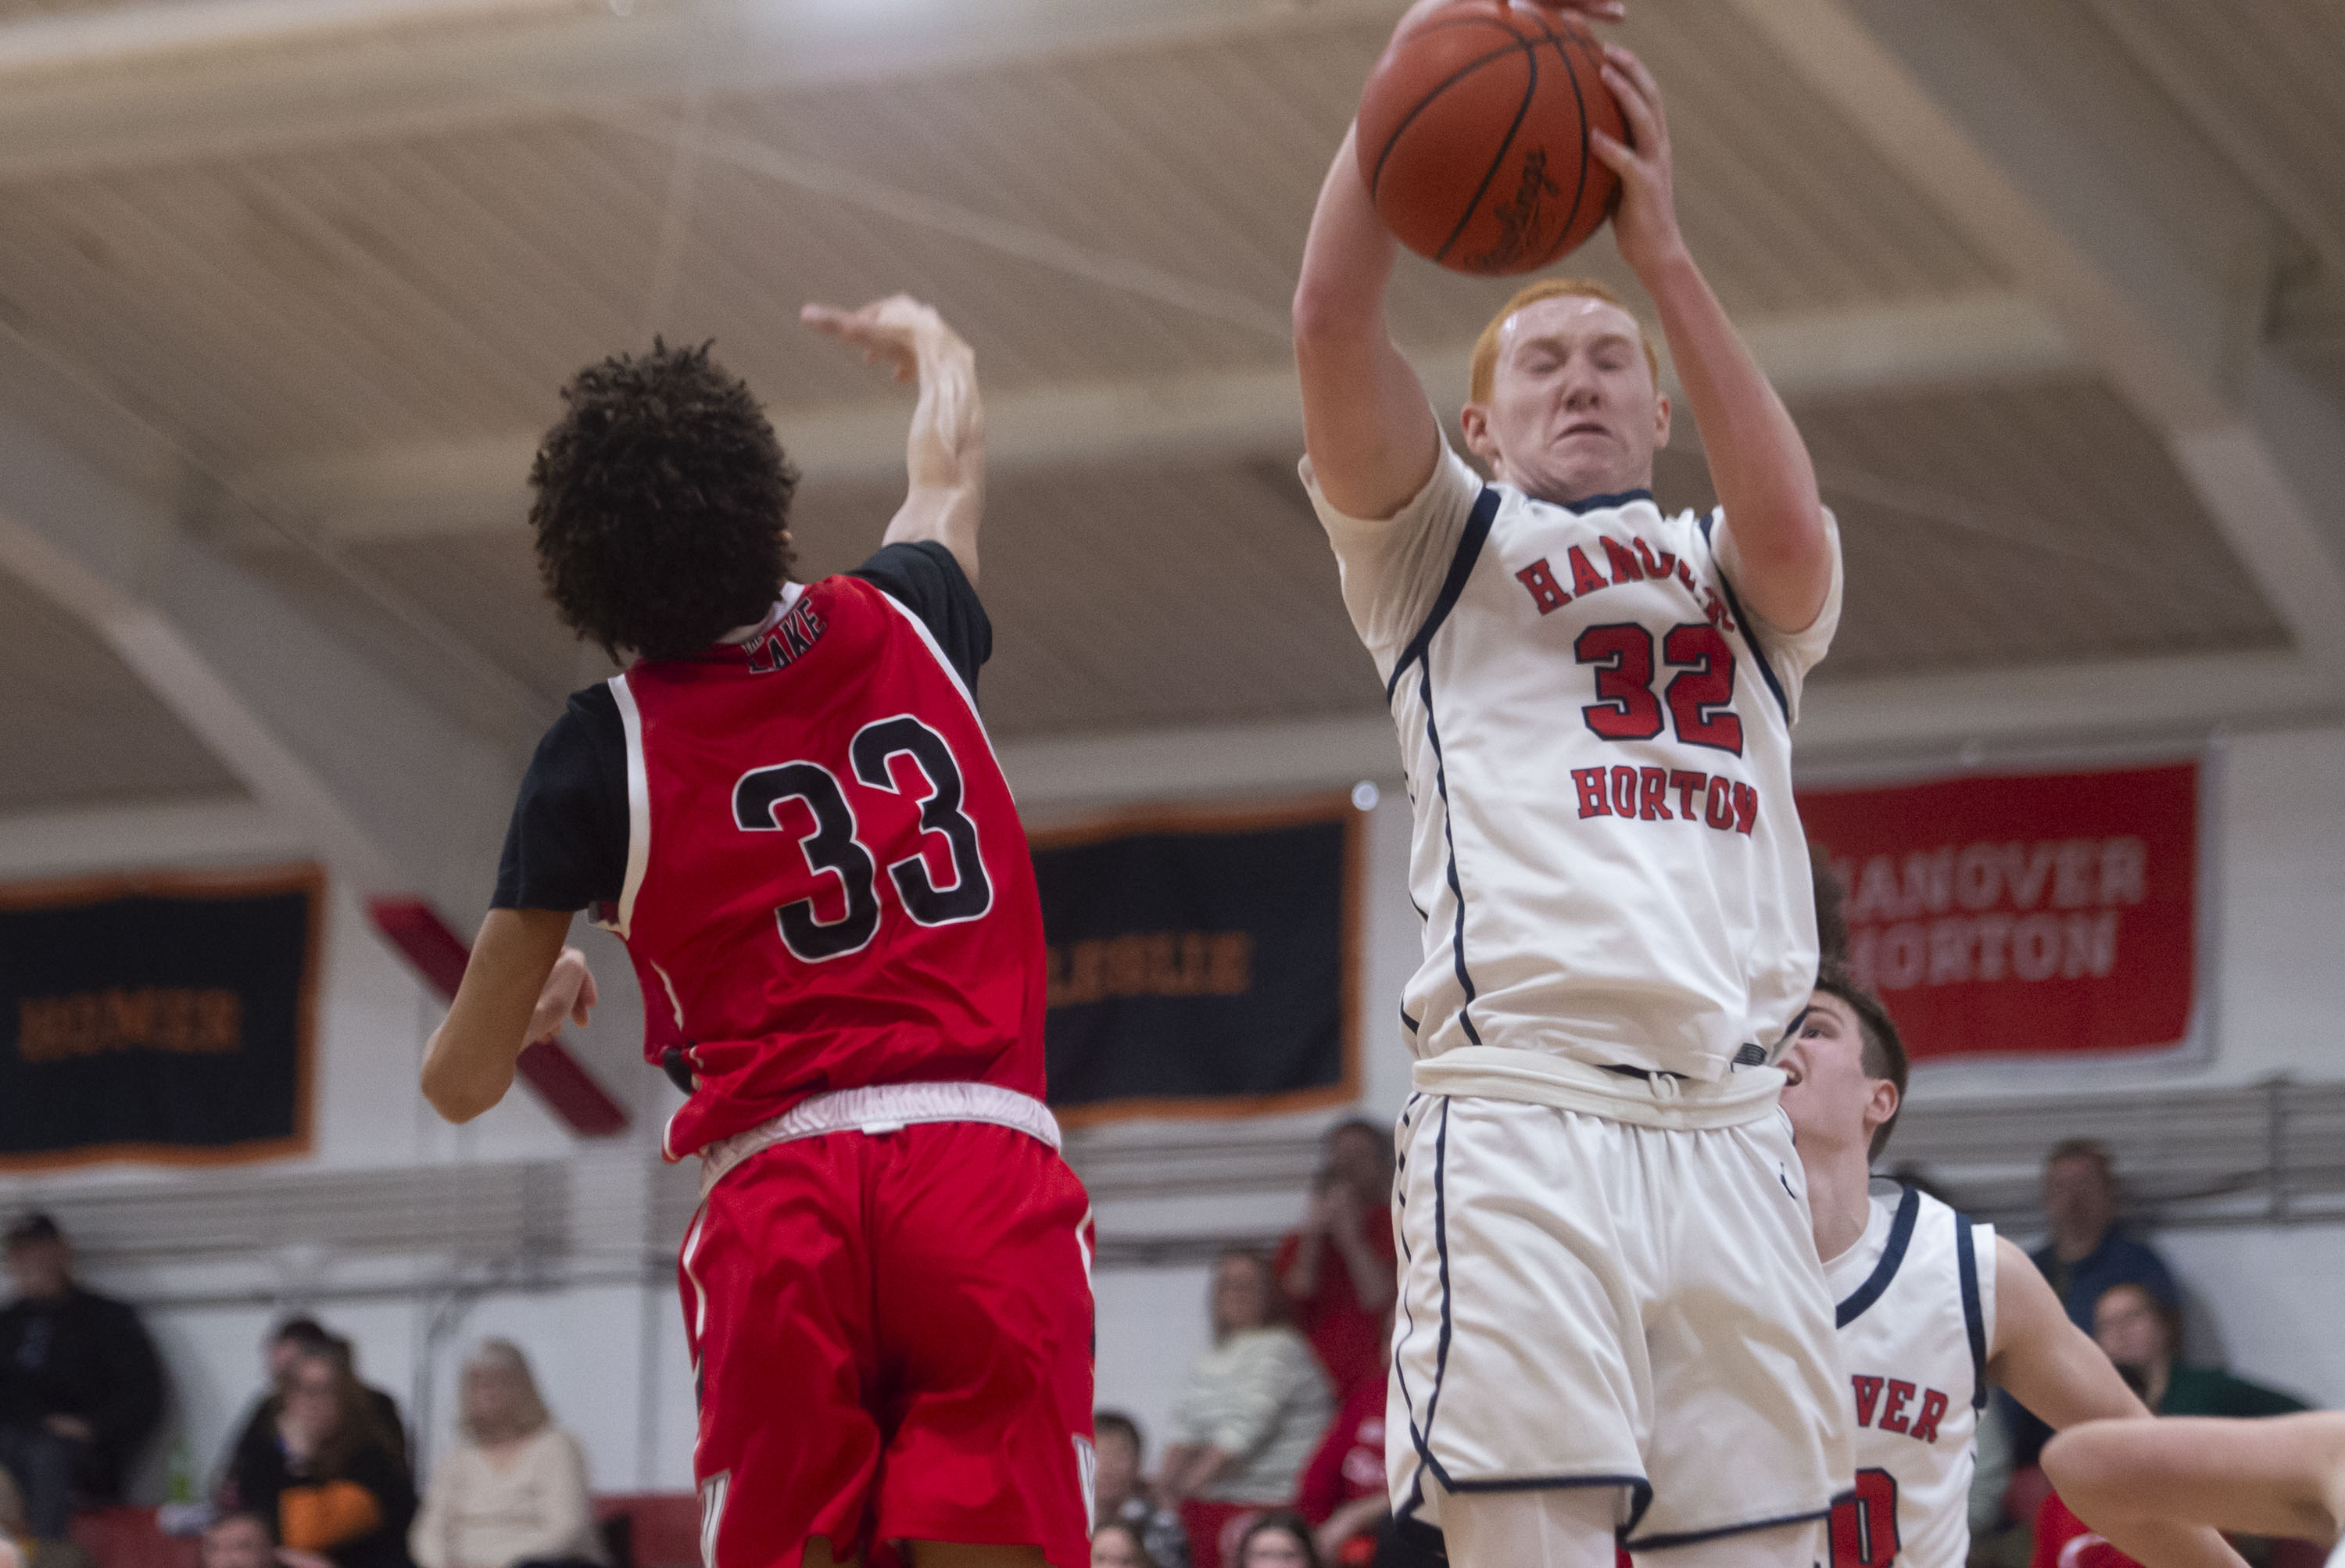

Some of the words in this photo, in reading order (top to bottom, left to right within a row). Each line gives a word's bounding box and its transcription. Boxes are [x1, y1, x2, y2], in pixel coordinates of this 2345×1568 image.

[1515, 535, 1735, 633] HANR
[748, 597, 827, 675] LAKE
[1573, 621, 1744, 759] 32
[732, 713, 993, 963] 33
[1570, 764, 1758, 838] HORTON
